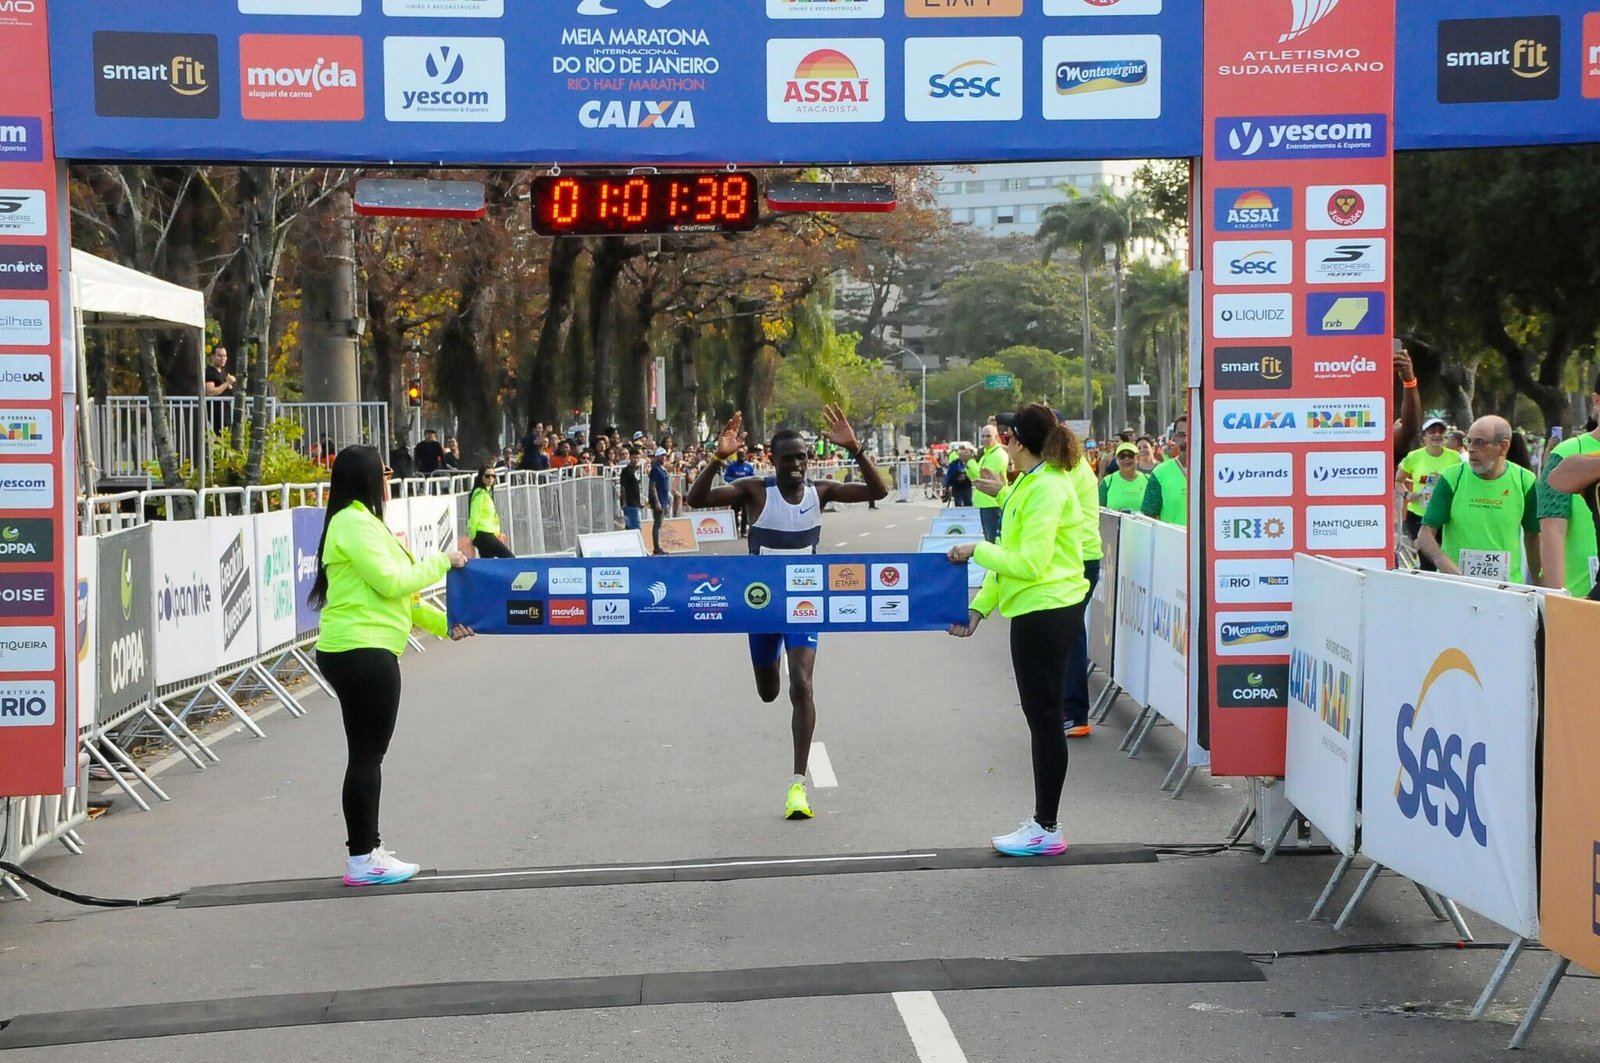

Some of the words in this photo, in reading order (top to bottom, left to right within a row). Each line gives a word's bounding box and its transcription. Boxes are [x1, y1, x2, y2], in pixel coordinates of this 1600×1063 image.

[561, 28, 605, 45] MEIA
[608, 28, 710, 46] MARATONA
[1242, 48, 1360, 61] ATLETISMO
[553, 57, 581, 74] DO
[585, 57, 616, 74] RIO
[620, 57, 642, 74] DE
[645, 57, 720, 74] JANEIRO
[1218, 61, 1384, 76] SUDAMERICANO
[247, 57, 357, 91] movida
[567, 78, 590, 91] RIO
[593, 79, 625, 91] HALF
[628, 79, 706, 91] MARATHON
[929, 74, 1000, 98] Sesc
[248, 90, 277, 98] aluguel
[402, 91, 488, 109] yescom
[578, 100, 696, 128] CAIXA
[796, 105, 858, 113] ATACADISTA
[1268, 123, 1372, 147] yescom
[679, 224, 716, 232] ChipTiming
[1230, 259, 1277, 275] Sesc
[1320, 263, 1371, 271] SKECHERS
[1235, 310, 1285, 321] LIQUIDZ
[1325, 319, 1342, 328] rvb
[1314, 355, 1377, 374] movida
[1223, 411, 1296, 430] CAIXA
[1306, 410, 1376, 428] BRASIL
[1238, 469, 1288, 481] ybrands
[1331, 466, 1378, 477] yescom
[1222, 519, 1231, 539] visit
[1313, 519, 1379, 529] MANTIQUEIRA
[1485, 554, 1500, 562] 5K
[1470, 566, 1499, 576] 27465
[1230, 578, 1250, 588] RIO
[0, 589, 45, 601] OISE
[598, 614, 625, 622] yescom
[694, 612, 723, 620] CAIXA
[111, 632, 145, 694] COPRA
[1290, 646, 1318, 712] CAIXA
[1232, 688, 1278, 700] COPRA
[1, 697, 47, 716] RIO
[1396, 702, 1488, 848] Sesc
